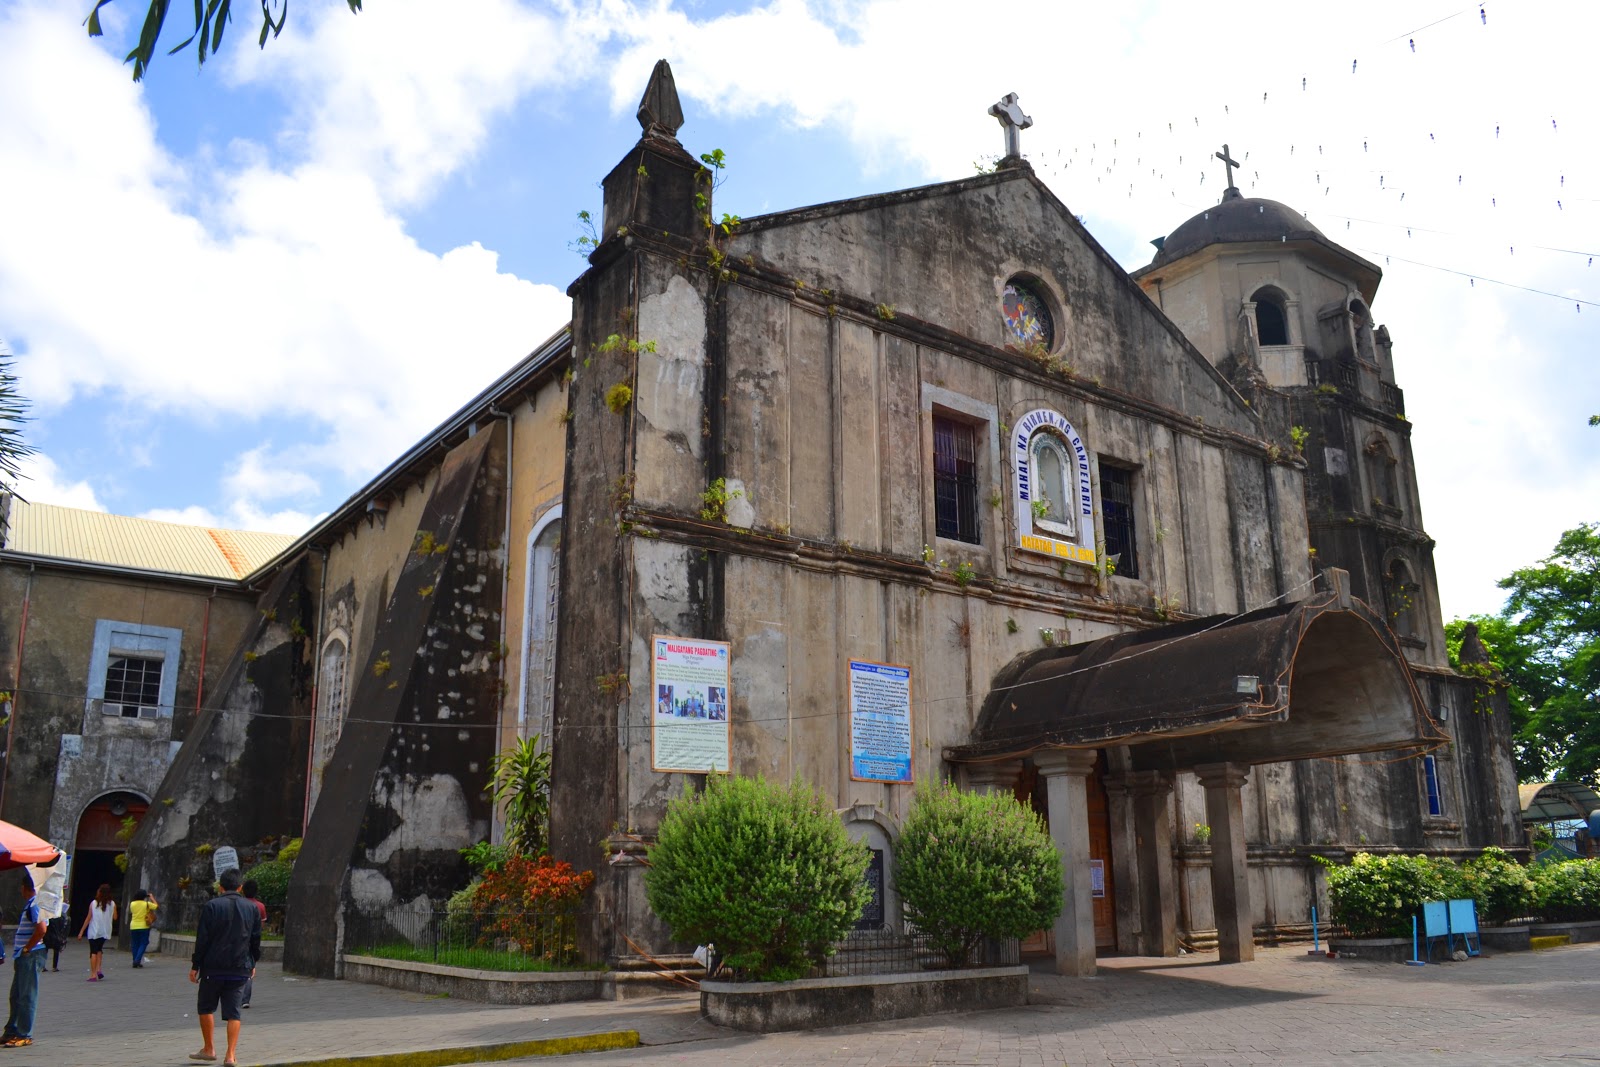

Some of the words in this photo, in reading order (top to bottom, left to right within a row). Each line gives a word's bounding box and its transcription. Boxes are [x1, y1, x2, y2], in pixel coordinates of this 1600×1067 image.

[1022, 411, 1054, 432] BIRHEN
[1058, 418, 1071, 435] NG
[1017, 434, 1028, 451] NA
[1018, 460, 1029, 501] MAHAL
[1072, 437, 1091, 515] CANDELARIA
[668, 644, 694, 654] MALIGAYANG
[694, 647, 717, 657] PAGDATING
